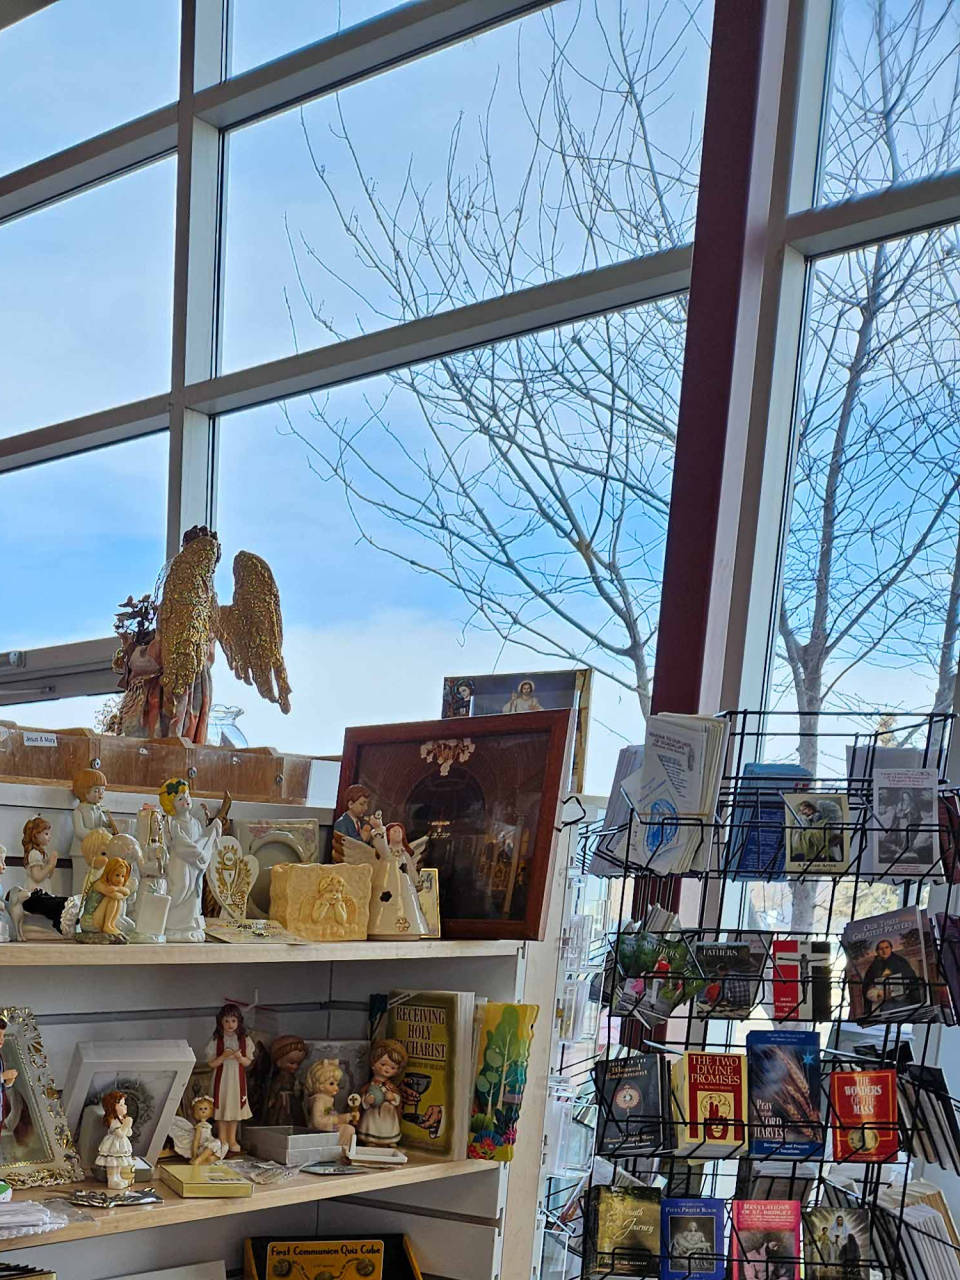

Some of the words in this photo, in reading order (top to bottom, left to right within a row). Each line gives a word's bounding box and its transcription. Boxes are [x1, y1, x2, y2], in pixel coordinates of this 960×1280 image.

[25, 735, 38, 744] Jesus
[44, 737, 56, 745] Mary
[884, 921, 913, 934] PRAYERS
[644, 940, 680, 959] MOTHERS
[703, 948, 738, 957] FATHERS
[396, 1006, 445, 1025] RECEIVING
[407, 1024, 433, 1041] HOLY
[691, 1055, 713, 1066] THE
[714, 1056, 739, 1067] TWO
[696, 1065, 734, 1075] DIVINE
[691, 1074, 741, 1085] PROMISES
[855, 1076, 870, 1086] THE
[844, 1086, 882, 1096] WONDERS
[756, 1100, 774, 1112] Pray
[853, 1105, 874, 1115] MASS
[613, 1217, 654, 1240] Journey
[271, 1246, 290, 1256] First
[293, 1246, 339, 1256] Communion
[340, 1245, 358, 1257] Quiz
[360, 1244, 381, 1255] Cube
